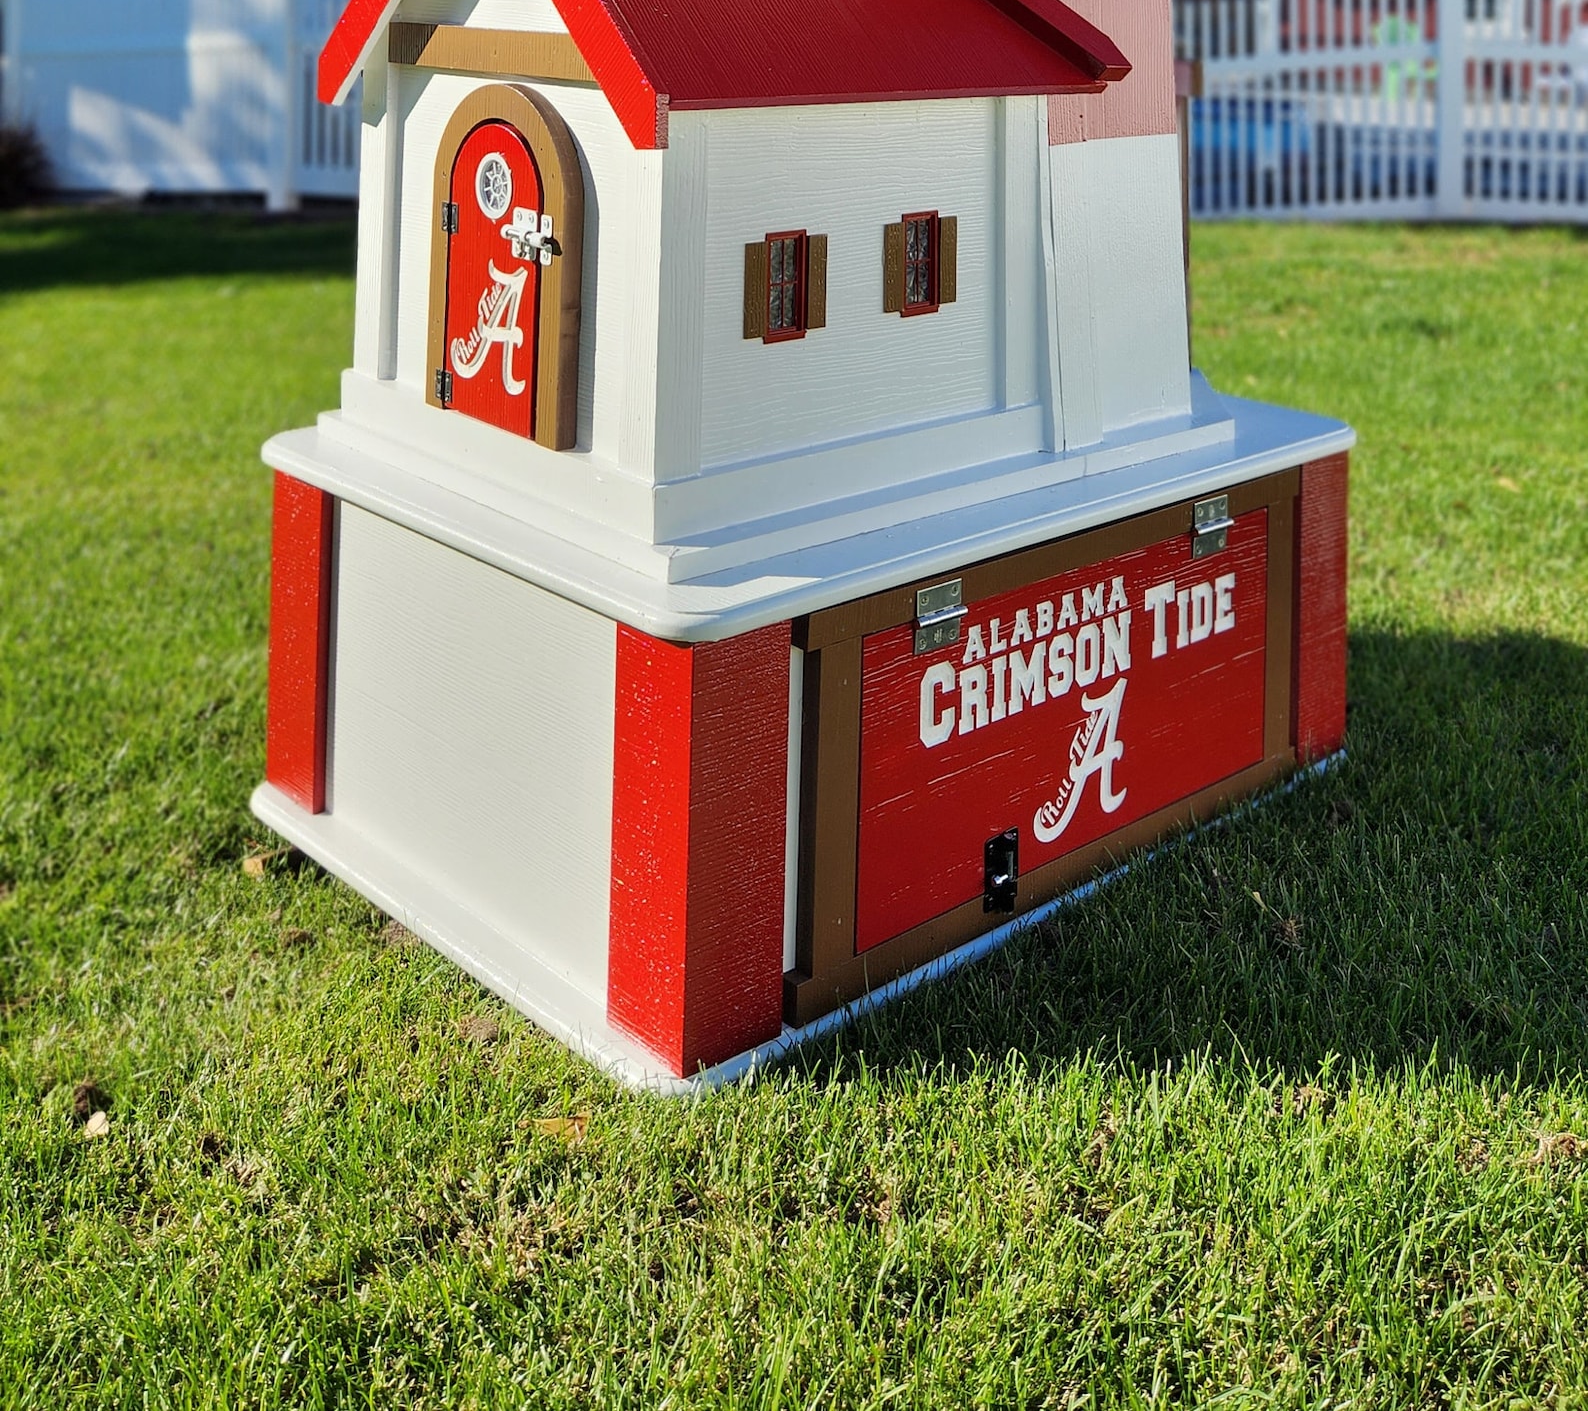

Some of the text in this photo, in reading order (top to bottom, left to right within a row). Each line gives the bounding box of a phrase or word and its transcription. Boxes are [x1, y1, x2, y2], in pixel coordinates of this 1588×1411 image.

[450, 258, 528, 395] A
[456, 327, 482, 364] Roll
[919, 573, 1236, 749] CRIMSON TIDE
[962, 575, 1129, 665] ALABAMA
[1033, 677, 1128, 843] A
[1041, 711, 1098, 825] Roll Tide
